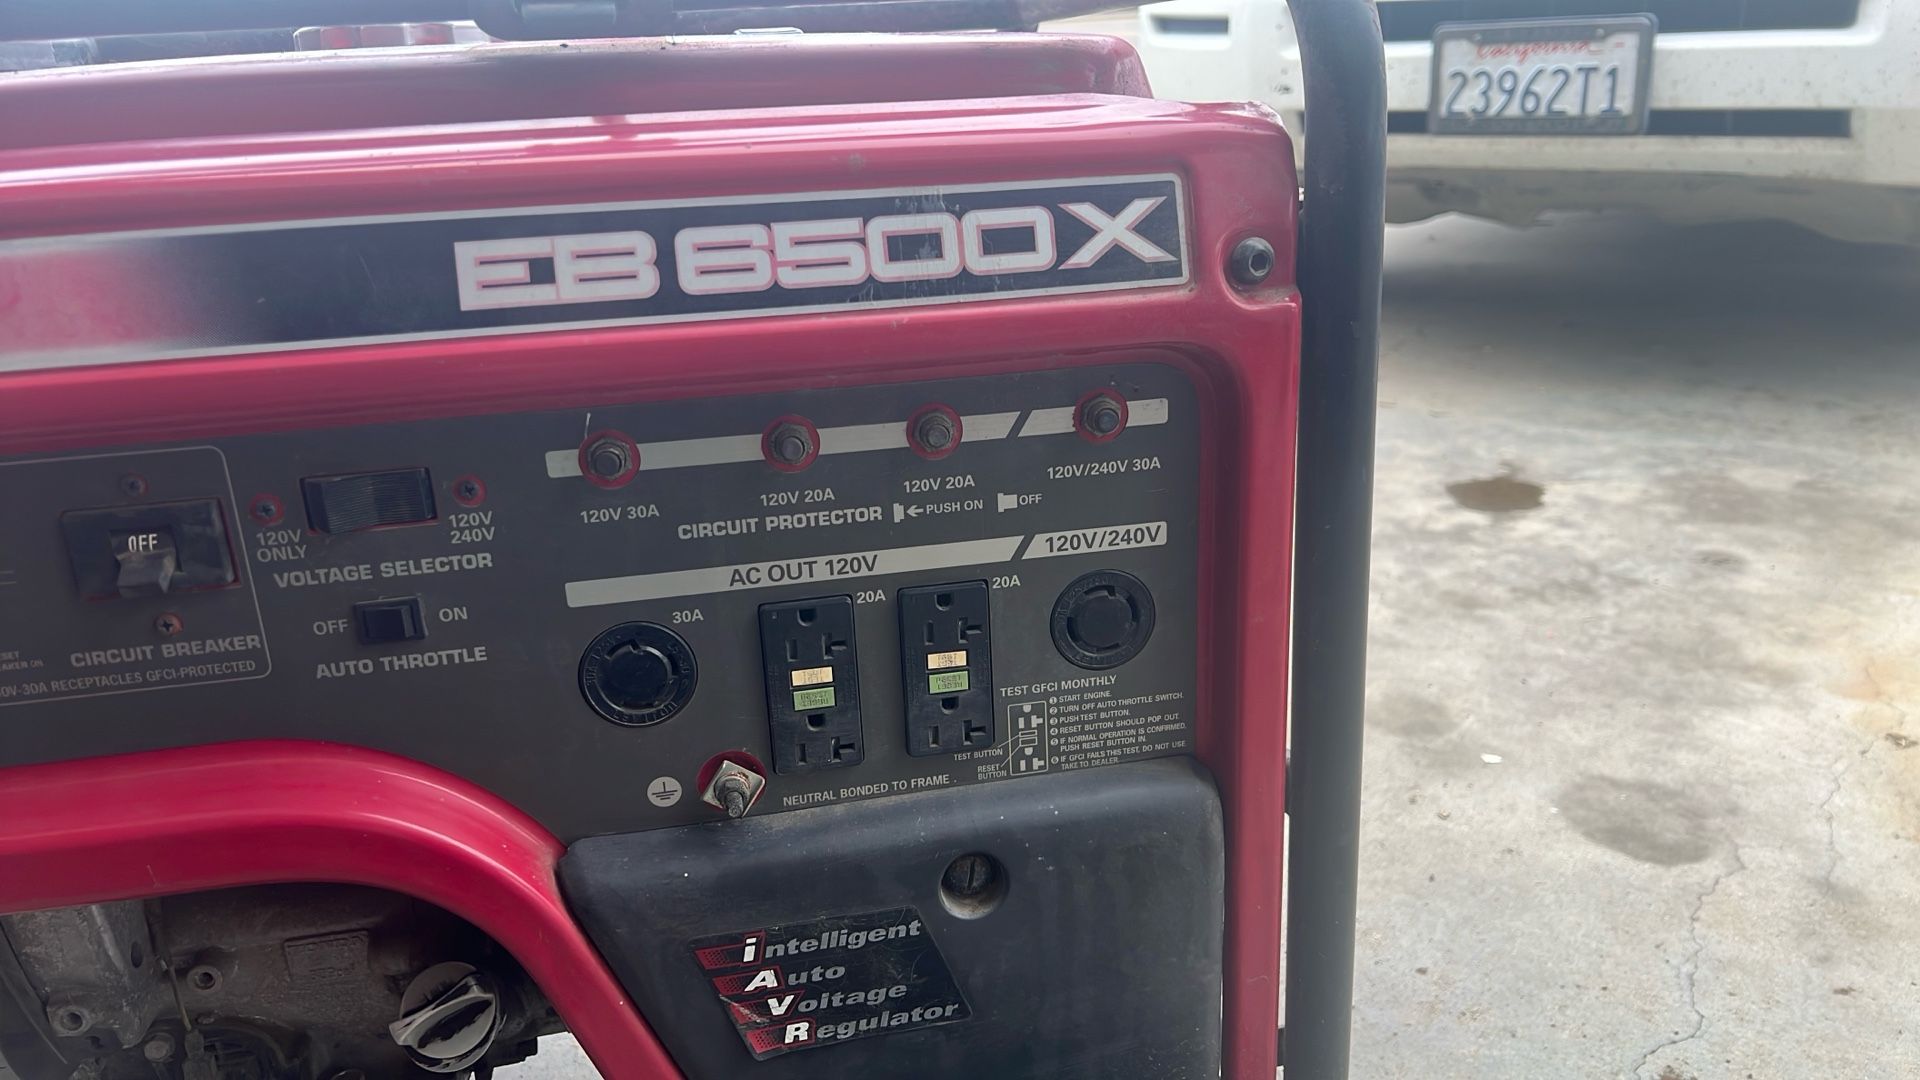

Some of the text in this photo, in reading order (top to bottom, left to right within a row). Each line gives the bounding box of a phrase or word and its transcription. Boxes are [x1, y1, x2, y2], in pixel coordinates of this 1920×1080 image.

[1445, 64, 1623, 117] 23962T1
[1047, 456, 1161, 480] 120V/240V 30A
[903, 474, 975, 494] 120V 20A
[760, 487, 835, 507] 120V 20A
[1019, 493, 1043, 506] OFF
[580, 504, 660, 524] 120V 30A
[926, 499, 984, 515] PUSH ON
[448, 511, 493, 528] 120V
[678, 505, 883, 540] CIRCUIT PROTECTOR
[128, 534, 158, 553] OFF
[256, 529, 302, 546] 120V
[450, 527, 495, 545] 240V
[1045, 524, 1162, 553] 120V/240V
[256, 544, 307, 563] ONLY
[273, 552, 493, 588] VOLTAGE SELECTOR
[730, 554, 878, 587] AC OUT 120V
[992, 575, 1021, 590] 20A
[857, 589, 886, 604] 20A
[438, 606, 468, 622] ON
[672, 608, 704, 625] 30A
[313, 619, 349, 636] OFF
[70, 634, 262, 668] CIRCUIT BREAKER
[316, 646, 488, 679] AUTO THROTTLE
[51, 672, 143, 694] RECEPTACLES
[146, 660, 256, 681] GFCI-PROTECTED
[1000, 674, 1117, 698] TEST GFCI MONTHLY
[1059, 695, 1081, 703] START
[1059, 705, 1079, 714] TURN
[1082, 702, 1096, 711] OFF
[1097, 700, 1117, 709] AUTO
[1118, 696, 1153, 706] THROTTLE
[1059, 715, 1079, 724] PUSH
[1080, 712, 1098, 721] TEST
[1059, 726, 1081, 735] RESET
[1084, 721, 1114, 731] BUTTON
[1116, 717, 1145, 728] SHOULD
[1147, 715, 1162, 723] POP
[1060, 737, 1067, 745] IF
[1068, 733, 1097, 744] NORMAL
[1099, 728, 1136, 740] OPERATION
[1138, 727, 1145, 735] IS
[1060, 743, 1080, 752] PUSH
[1083, 740, 1105, 750] RESET
[1106, 736, 1137, 747] BUTTON
[954, 748, 1003, 761] TEST BUTTON
[1060, 755, 1067, 763] IF
[1069, 752, 1085, 761] GFCI
[1086, 749, 1106, 759] FAILS
[1106, 748, 1121, 757] THIS
[1142, 744, 1153, 753] DO
[1154, 742, 1169, 751] NOT
[977, 764, 1000, 773] RESET
[1079, 760, 1089, 768] TO
[978, 769, 1007, 781] BUTTON
[783, 790, 837, 807] NEUTRAL
[840, 783, 889, 798] BONDED
[892, 780, 908, 792] TO
[744, 965, 846, 992] Auto
[784, 1002, 960, 1044] Regulator
